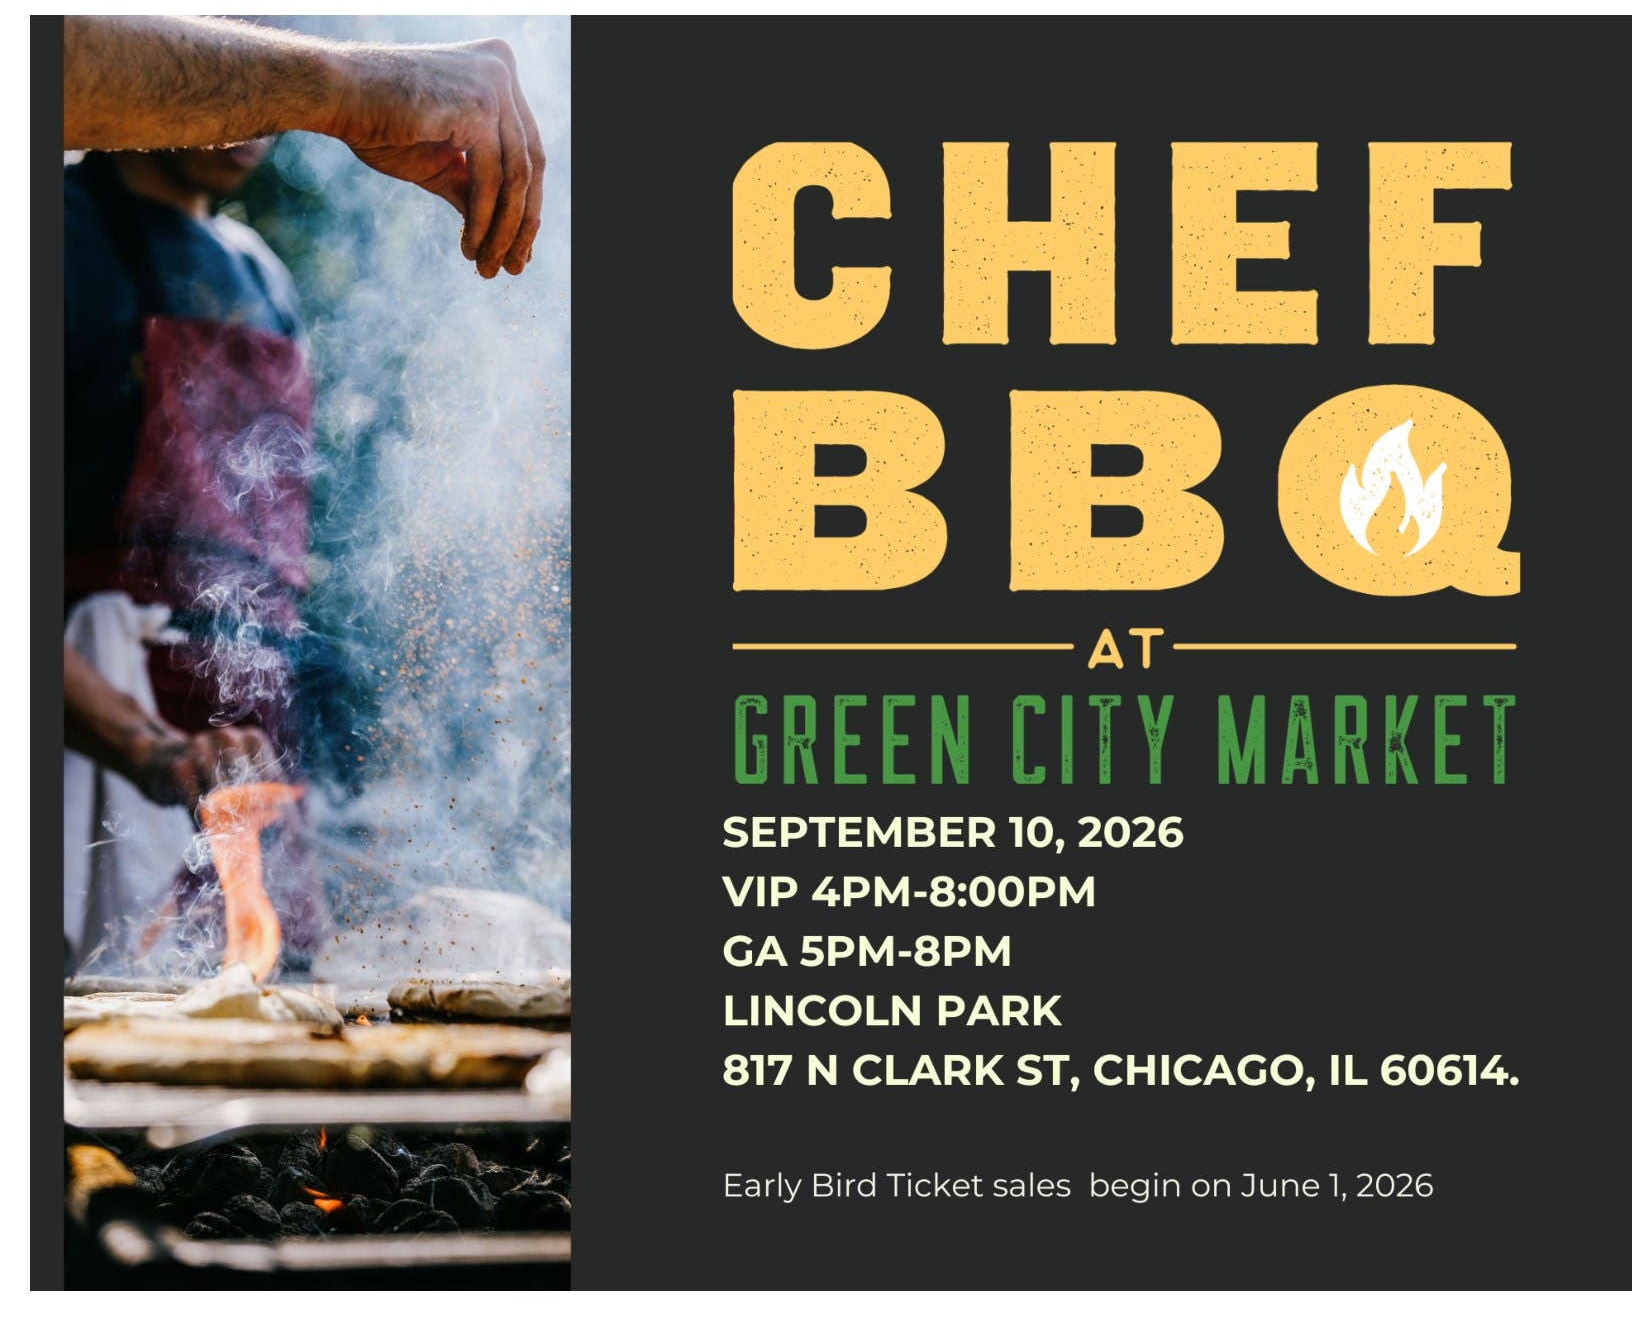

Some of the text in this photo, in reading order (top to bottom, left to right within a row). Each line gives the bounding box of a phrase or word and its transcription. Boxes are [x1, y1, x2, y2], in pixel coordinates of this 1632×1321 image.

[732, 142, 1513, 350] CHEF
[733, 384, 1521, 597] BBQ
[1088, 628, 1164, 669] AT
[735, 695, 1515, 784] GREEN CITY MARKET
[723, 816, 1184, 854] SEPTEMBER 10, 2026
[721, 875, 1094, 907] VIP 4PM-8:00PM
[723, 935, 1010, 967] GA 5PM-8PM
[725, 995, 1062, 1027] LINCOLN PARK
[723, 1054, 1519, 1092] 817 N CLARK ST, CHICAGO, IL 60614.
[725, 1172, 1433, 1203] Early Bird Ticket sales begin on June 1, 2026
